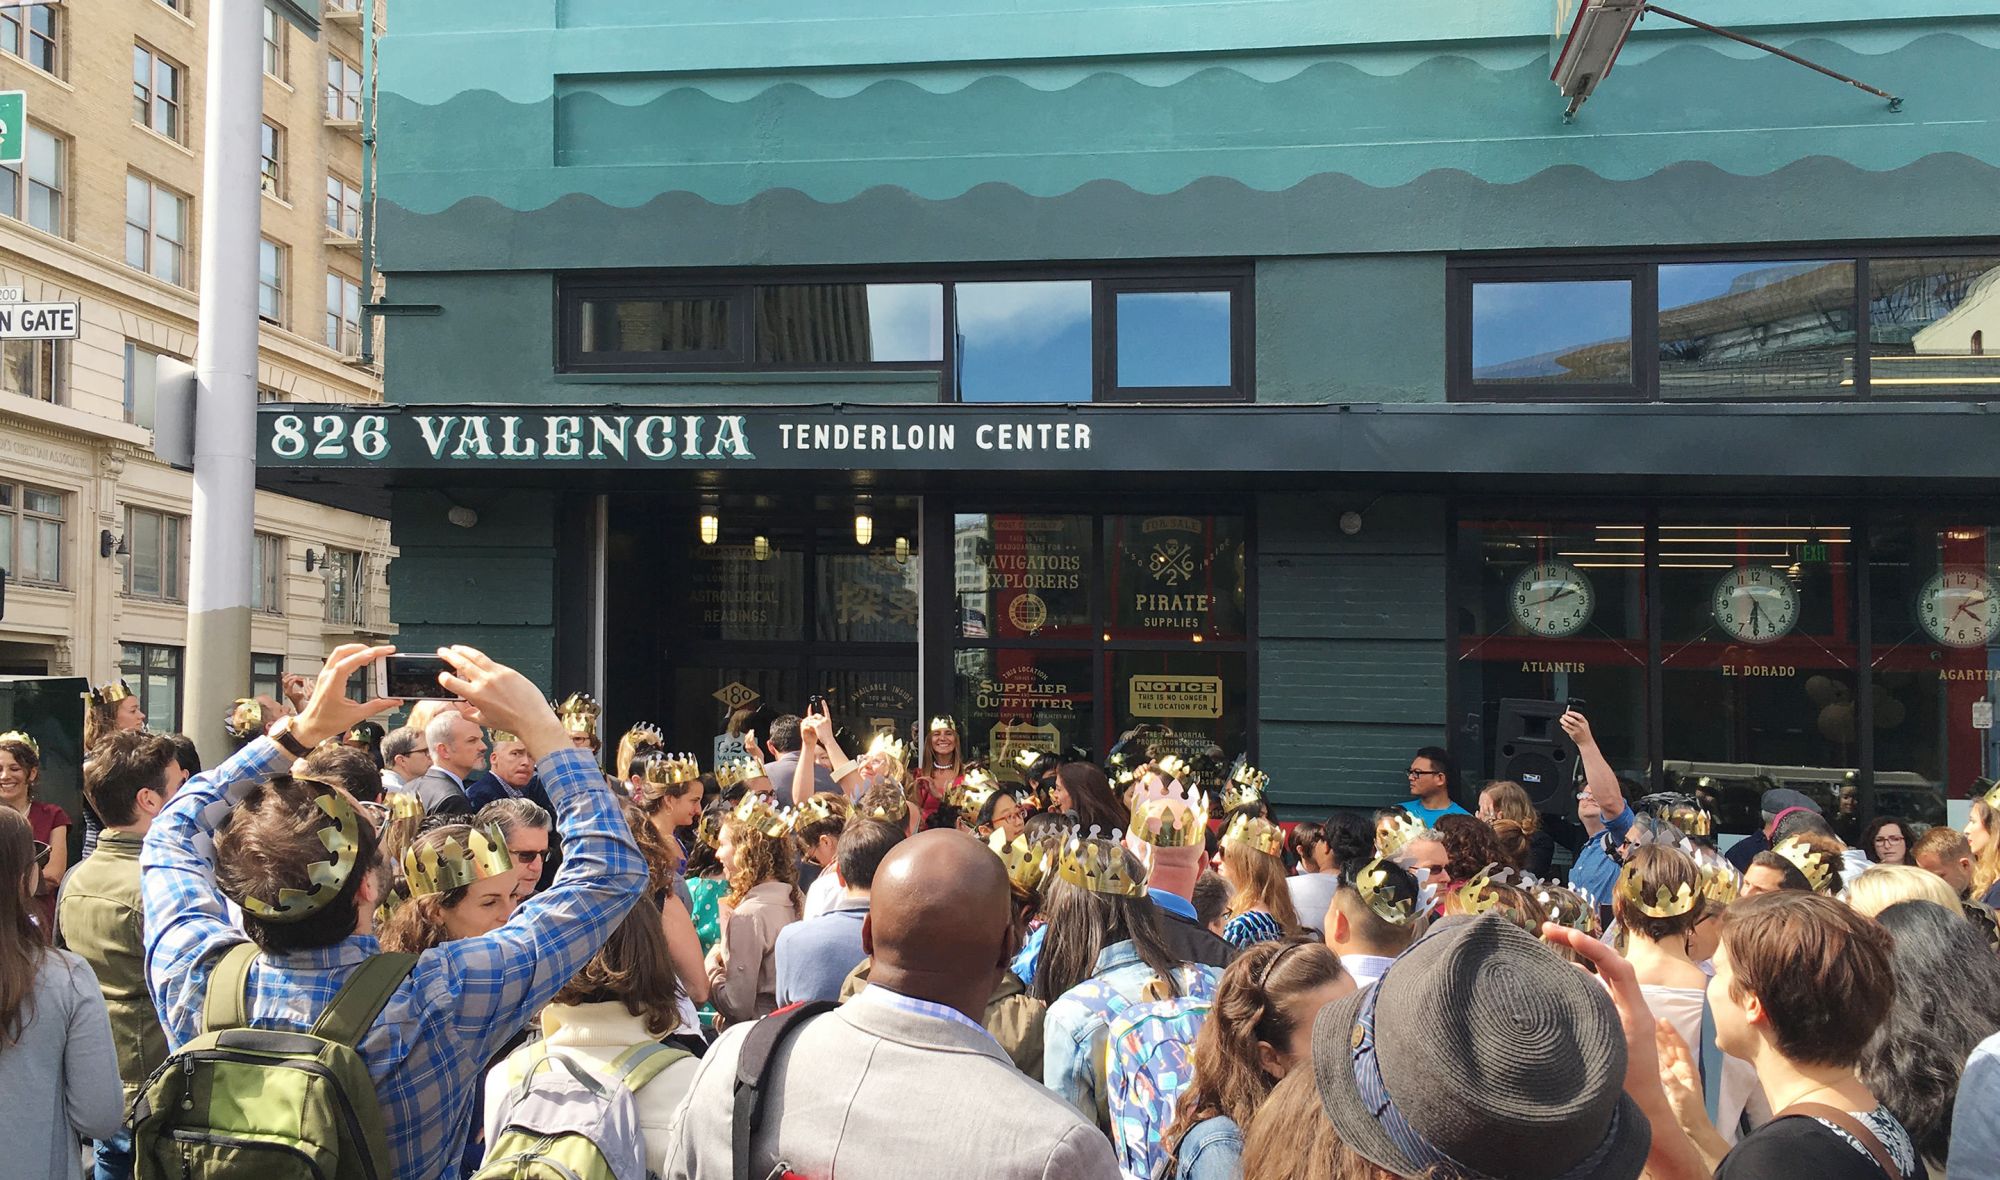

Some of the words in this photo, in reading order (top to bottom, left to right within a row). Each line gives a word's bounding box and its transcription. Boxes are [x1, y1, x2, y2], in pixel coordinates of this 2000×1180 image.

[21, 310, 74, 332] GATE
[271, 414, 391, 460] 826
[412, 415, 757, 461] VALENCIA
[779, 424, 955, 450] TENDERLOIN
[975, 424, 1091, 450] CENTER
[1803, 545, 1826, 561] EXIT
[976, 554, 1080, 570] NAVIGATORS
[1534, 571, 1540, 580] 11
[1547, 567, 1556, 578] 12
[1751, 572, 1760, 582] 12
[986, 573, 1079, 590] EXPLORERS
[1737, 576, 1744, 584] 11
[1942, 579, 1949, 588] 11
[1956, 574, 1966, 584] 12
[1522, 581, 1532, 591] 10
[1726, 586, 1735, 595] 10
[1780, 586, 1786, 596] 2
[688, 590, 780, 604] ASTROLOGICAL
[1930, 589, 1940, 599] 10
[1135, 594, 1209, 612] PIRATE
[1518, 595, 1526, 604] 9
[1579, 595, 1586, 605] 3
[1722, 600, 1728, 609] 9
[1784, 600, 1790, 610] 3
[1926, 603, 1934, 613] 9
[1990, 604, 1998, 614] 3
[704, 610, 768, 622] READINGS
[1522, 608, 1530, 618] 8
[1573, 609, 1580, 618] 4
[1144, 617, 1199, 628] SUPPLIES
[1535, 618, 1541, 626] 7
[1564, 618, 1570, 627] 5
[1726, 614, 1732, 623] 8
[1779, 614, 1786, 624] 4
[1930, 617, 1938, 626] 8
[1985, 618, 1992, 627] 4
[1548, 620, 1556, 630] 6
[1738, 622, 1744, 632] 7
[1768, 622, 1775, 632] 5
[1944, 626, 1950, 636] 7
[1958, 630, 1965, 640] 6
[1974, 627, 1982, 637] 5
[1522, 662, 1585, 673] ATLANTIS
[1722, 665, 1738, 676] EL
[1744, 666, 1796, 677] DORADO
[1002, 667, 1016, 679] THIS
[1018, 666, 1049, 680] LOCATION
[1938, 669, 2000, 680] AGARTHA
[980, 680, 1068, 695] SUPPLIER
[1136, 682, 1216, 692] NOTICE
[850, 682, 887, 704] AVAILABLE
[892, 685, 914, 704] INSIDE
[976, 694, 1074, 710] OUTFITTER
[1138, 702, 1152, 710] THE
